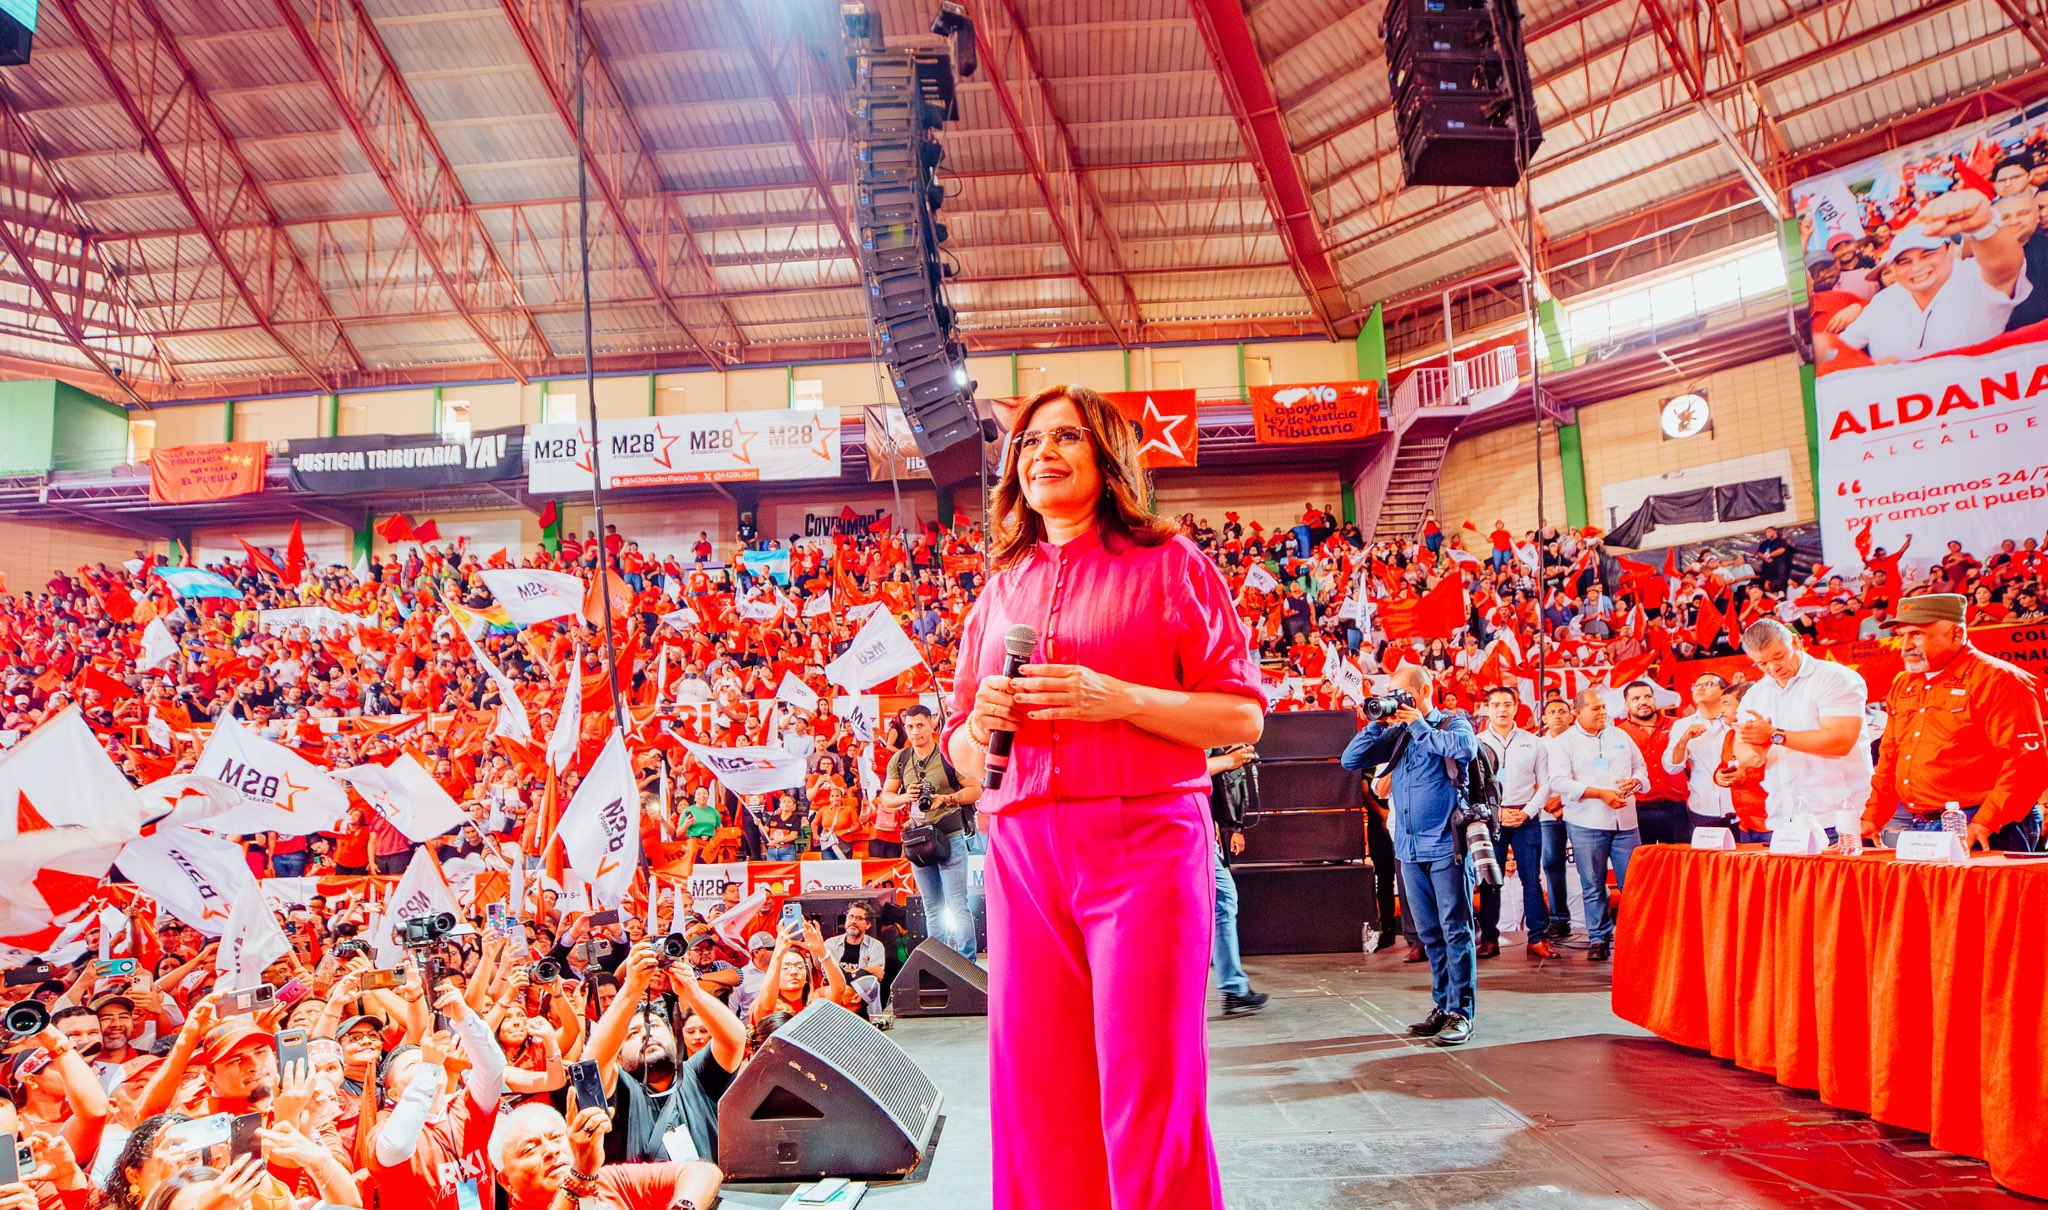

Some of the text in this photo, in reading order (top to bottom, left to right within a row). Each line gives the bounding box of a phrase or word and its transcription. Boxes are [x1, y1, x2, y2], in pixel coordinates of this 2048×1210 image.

[1275, 400, 1337, 416] apoyo la
[1829, 364, 2048, 441] ALDANA
[1264, 413, 1284, 426] Ley
[1287, 416, 1303, 425] de
[1267, 421, 1353, 438] Tributaria
[612, 434, 654, 454] M28
[690, 429, 733, 450] M28
[769, 425, 812, 445] M28
[1863, 416, 2038, 461] ALCALDE
[367, 445, 461, 470] TRIBUTARIA
[464, 434, 507, 469] YA!
[535, 439, 576, 459] M28
[1855, 477, 1992, 510] Trabajamos
[1845, 512, 1885, 532] por
[1888, 501, 1950, 522] amor
[1955, 494, 1979, 511] al
[218, 758, 280, 799] M28
